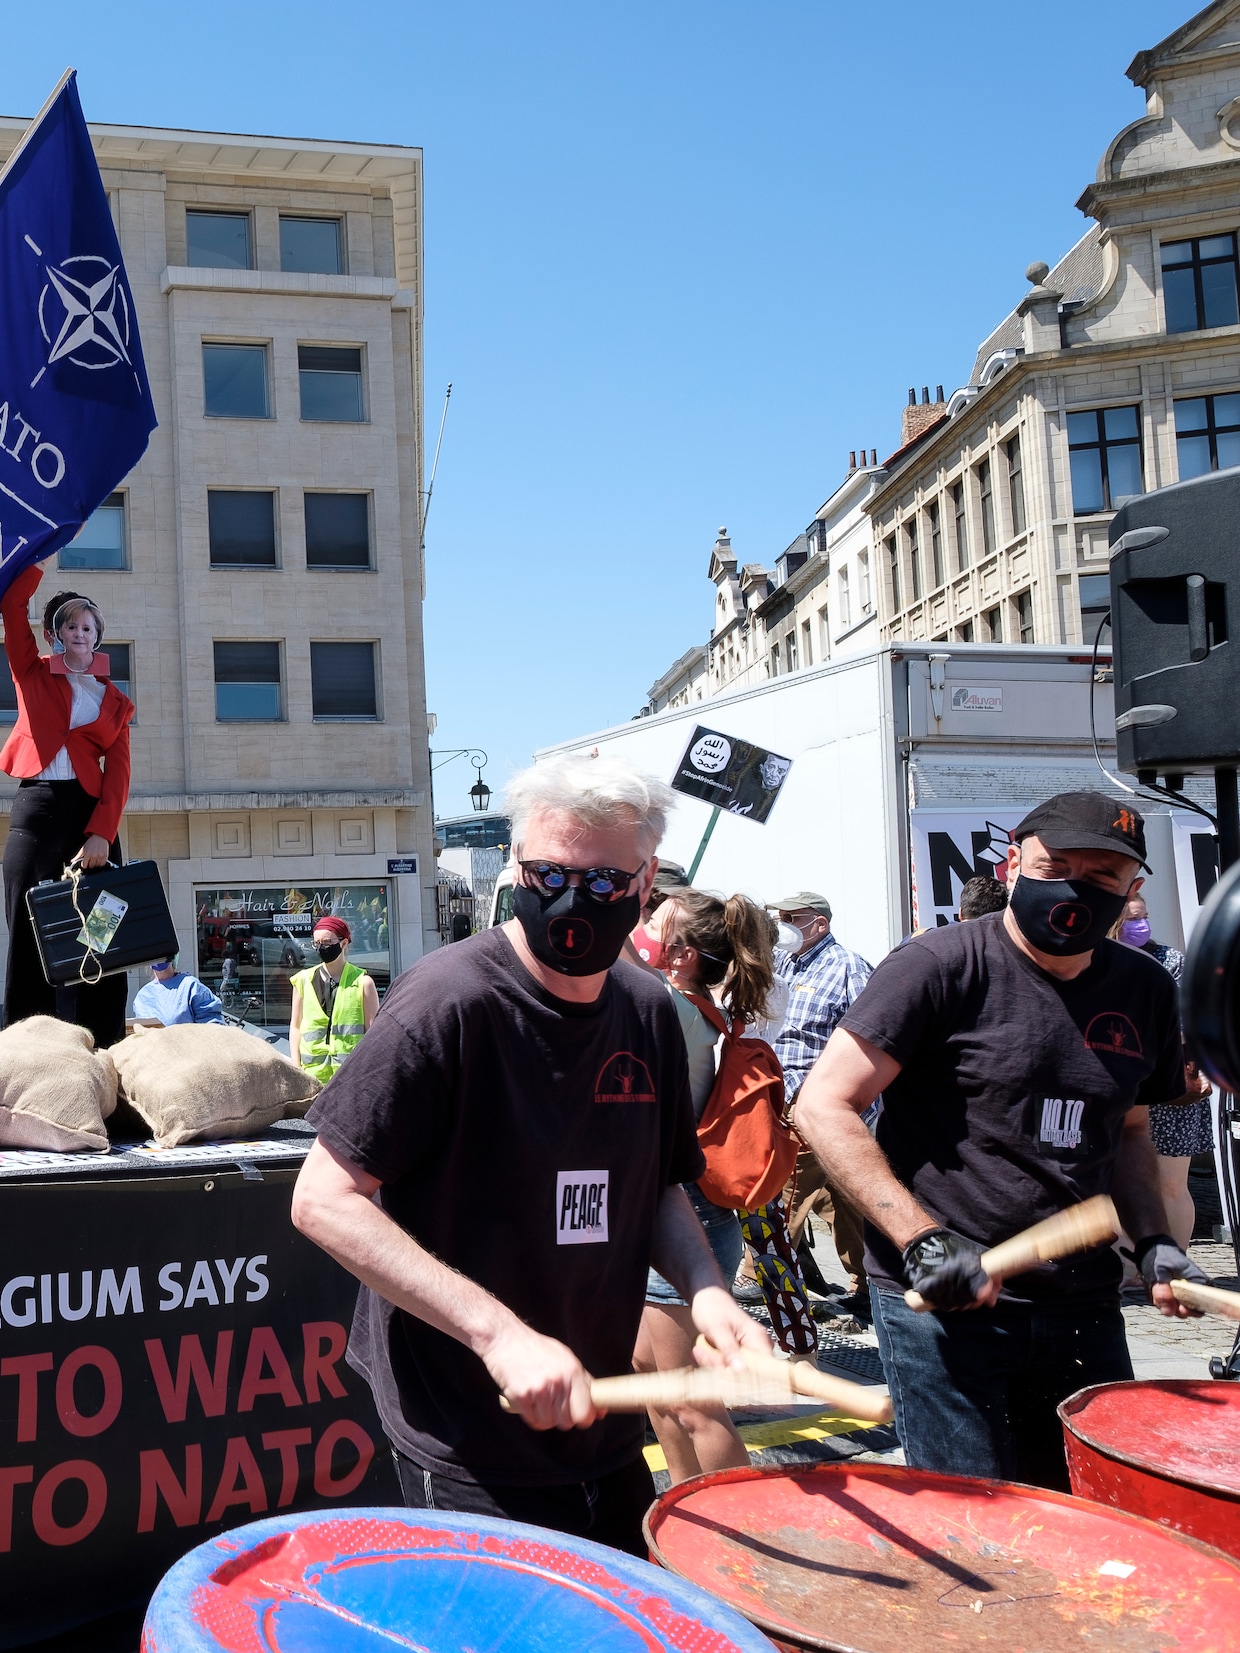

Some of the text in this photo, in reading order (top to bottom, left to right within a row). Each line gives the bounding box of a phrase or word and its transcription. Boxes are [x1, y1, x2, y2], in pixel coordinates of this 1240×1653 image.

[964, 694, 1001, 706] Aluvan
[681, 769, 733, 793] #StopAfrinGenocide
[99, 896, 107, 906] 100
[229, 889, 354, 913] Hair & Nails
[107, 913, 121, 930] 100
[274, 914, 311, 923] FASHION
[1040, 1098, 1085, 1131] NO TO
[560, 1183, 606, 1230] PEACE
[158, 1255, 270, 1312] SAYS
[0, 1345, 123, 1443] TO
[144, 1321, 349, 1424] WAR
[137, 1419, 375, 1534] NATO
